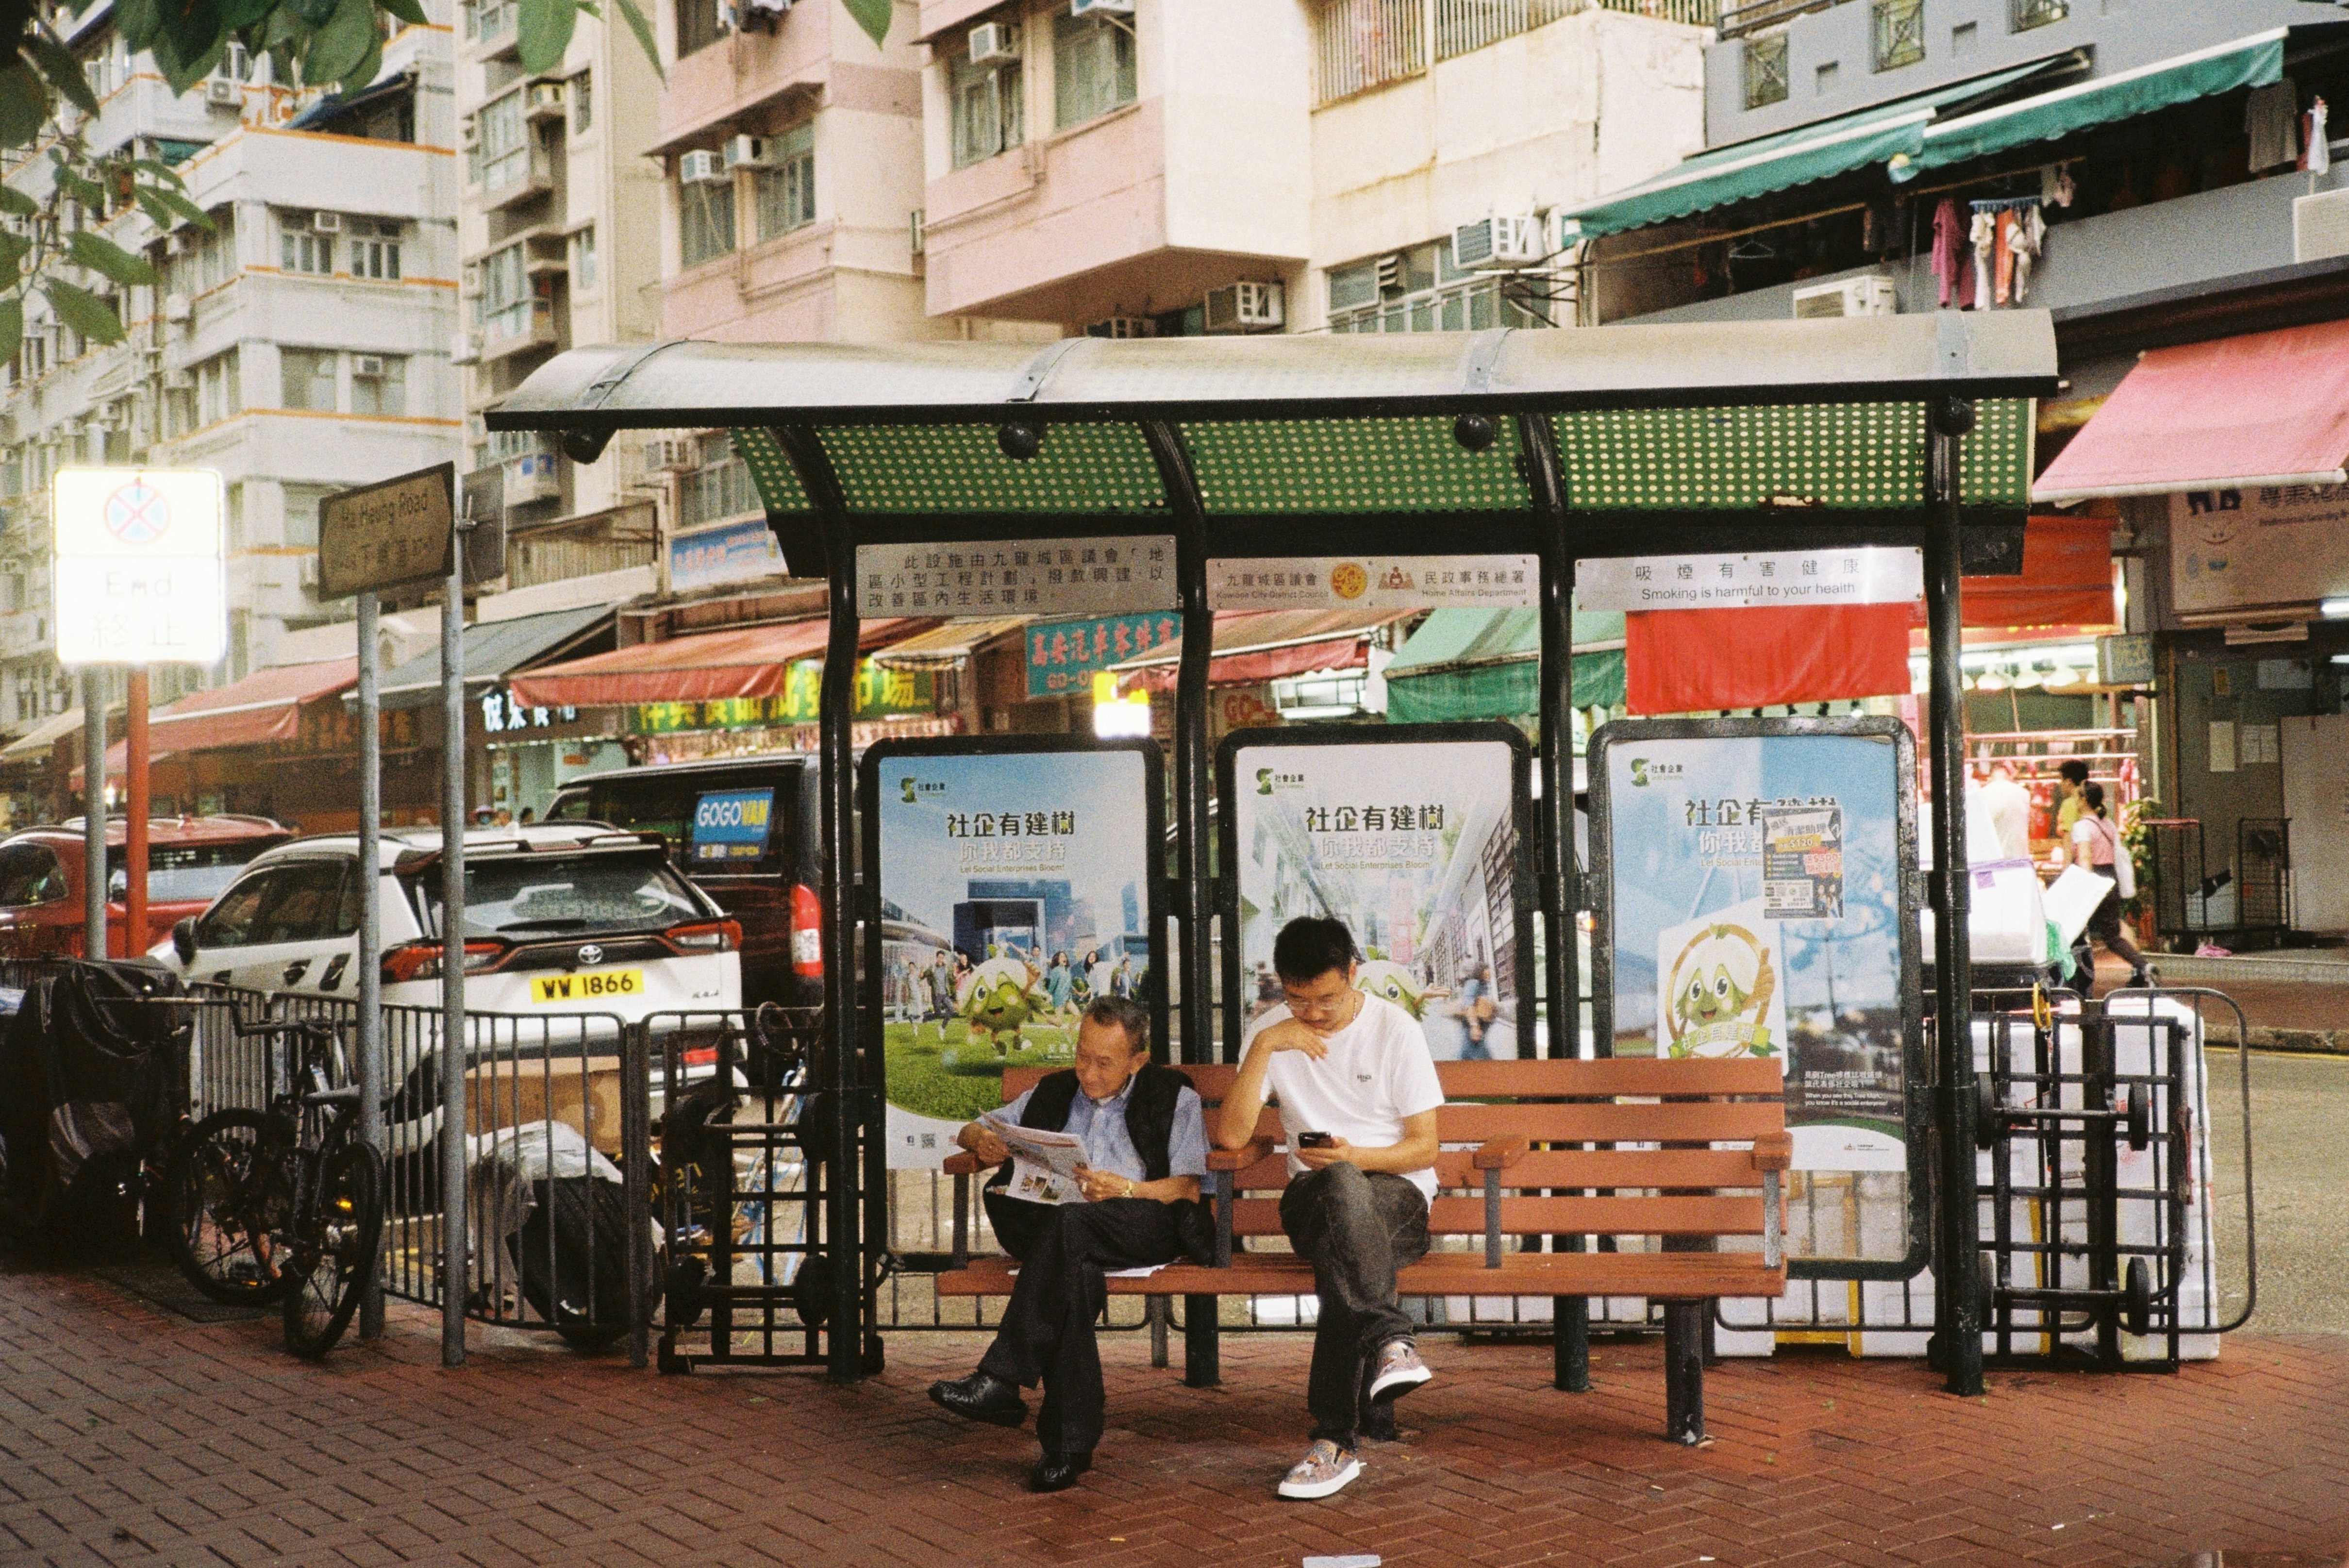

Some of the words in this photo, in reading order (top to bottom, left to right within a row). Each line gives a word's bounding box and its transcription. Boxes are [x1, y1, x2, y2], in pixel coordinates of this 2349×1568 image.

[1425, 570, 1524, 584] 民政事務總署
[1635, 559, 1860, 581] 吸煙有害健康
[105, 571, 172, 597] End
[1227, 572, 1316, 586] 九龍城區議會
[1251, 591, 1266, 600] City
[1478, 588, 1526, 597] Department
[1642, 588, 1697, 601] Smoking
[1701, 587, 1711, 598] is
[1716, 585, 1763, 597] harmful
[1768, 585, 1779, 596] to
[1784, 584, 1811, 598] your
[1816, 583, 1855, 594] health
[91, 611, 187, 649] 終止
[1651, 764, 1683, 773] 社會企業
[1274, 773, 1304, 783] 社會企業
[917, 782, 945, 791] 社會企業
[698, 800, 769, 826] GOGOVAN
[1306, 804, 1444, 832] 社企有建樹
[947, 810, 1074, 837] 社企有建樹
[961, 840, 1066, 861] 你我都支持
[1321, 836, 1434, 857] 你我都支持
[961, 865, 972, 873] Let
[973, 864, 995, 873] Social
[997, 864, 1037, 874] Enterprises
[1039, 863, 1065, 872] Bloom!
[1320, 861, 1332, 870] Let
[1334, 861, 1358, 869] Social
[1360, 860, 1403, 870] Enterprises
[1405, 860, 1433, 869] Bloom!
[1701, 857, 1714, 867] Let
[1716, 857, 1742, 867] Social
[583, 973, 633, 996] 1866
